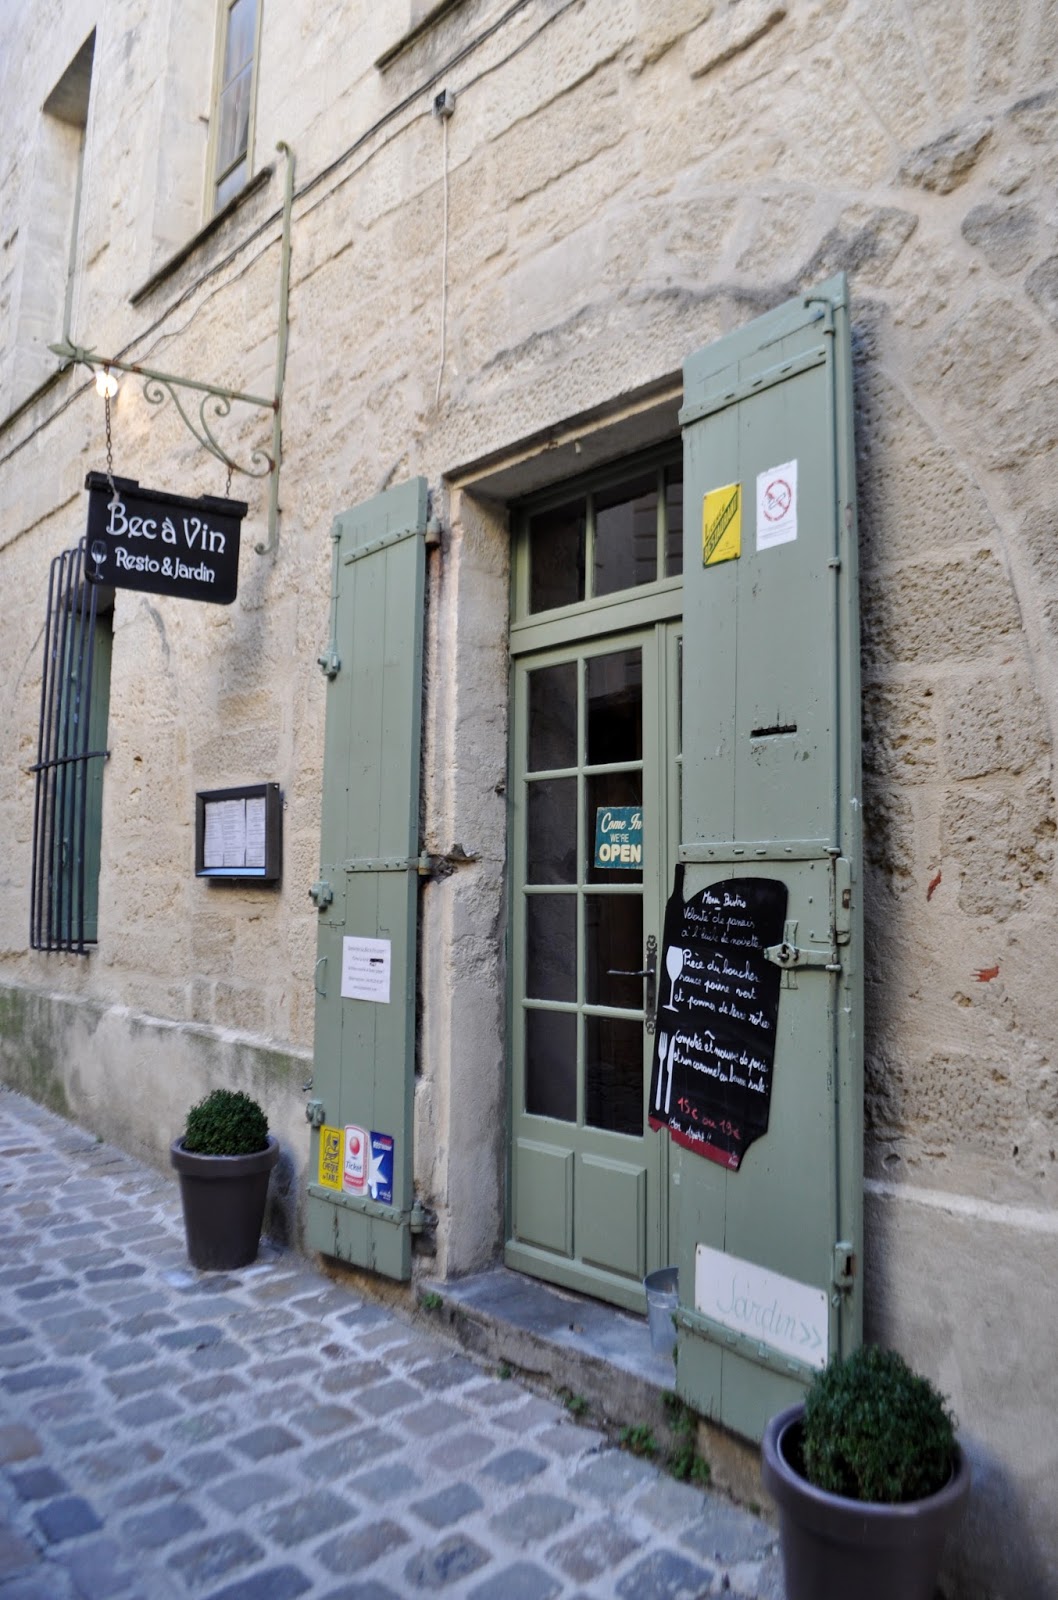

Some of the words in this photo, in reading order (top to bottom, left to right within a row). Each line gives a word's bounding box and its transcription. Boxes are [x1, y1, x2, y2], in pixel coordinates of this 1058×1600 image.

[106, 502, 157, 540] Bec
[161, 517, 177, 544] à
[183, 517, 226, 554] Vin
[114, 547, 159, 573] Resto
[173, 557, 215, 583] Jardin
[601, 812, 626, 833] Come
[628, 813, 642, 830] In
[610, 833, 629, 843] WE'RE
[599, 843, 642, 863] OPEN
[702, 890, 720, 905] Menu
[723, 893, 746, 908] Bistro
[712, 909, 724, 924] de
[683, 949, 705, 969] Pièce
[716, 1274, 797, 1342] Jardin
